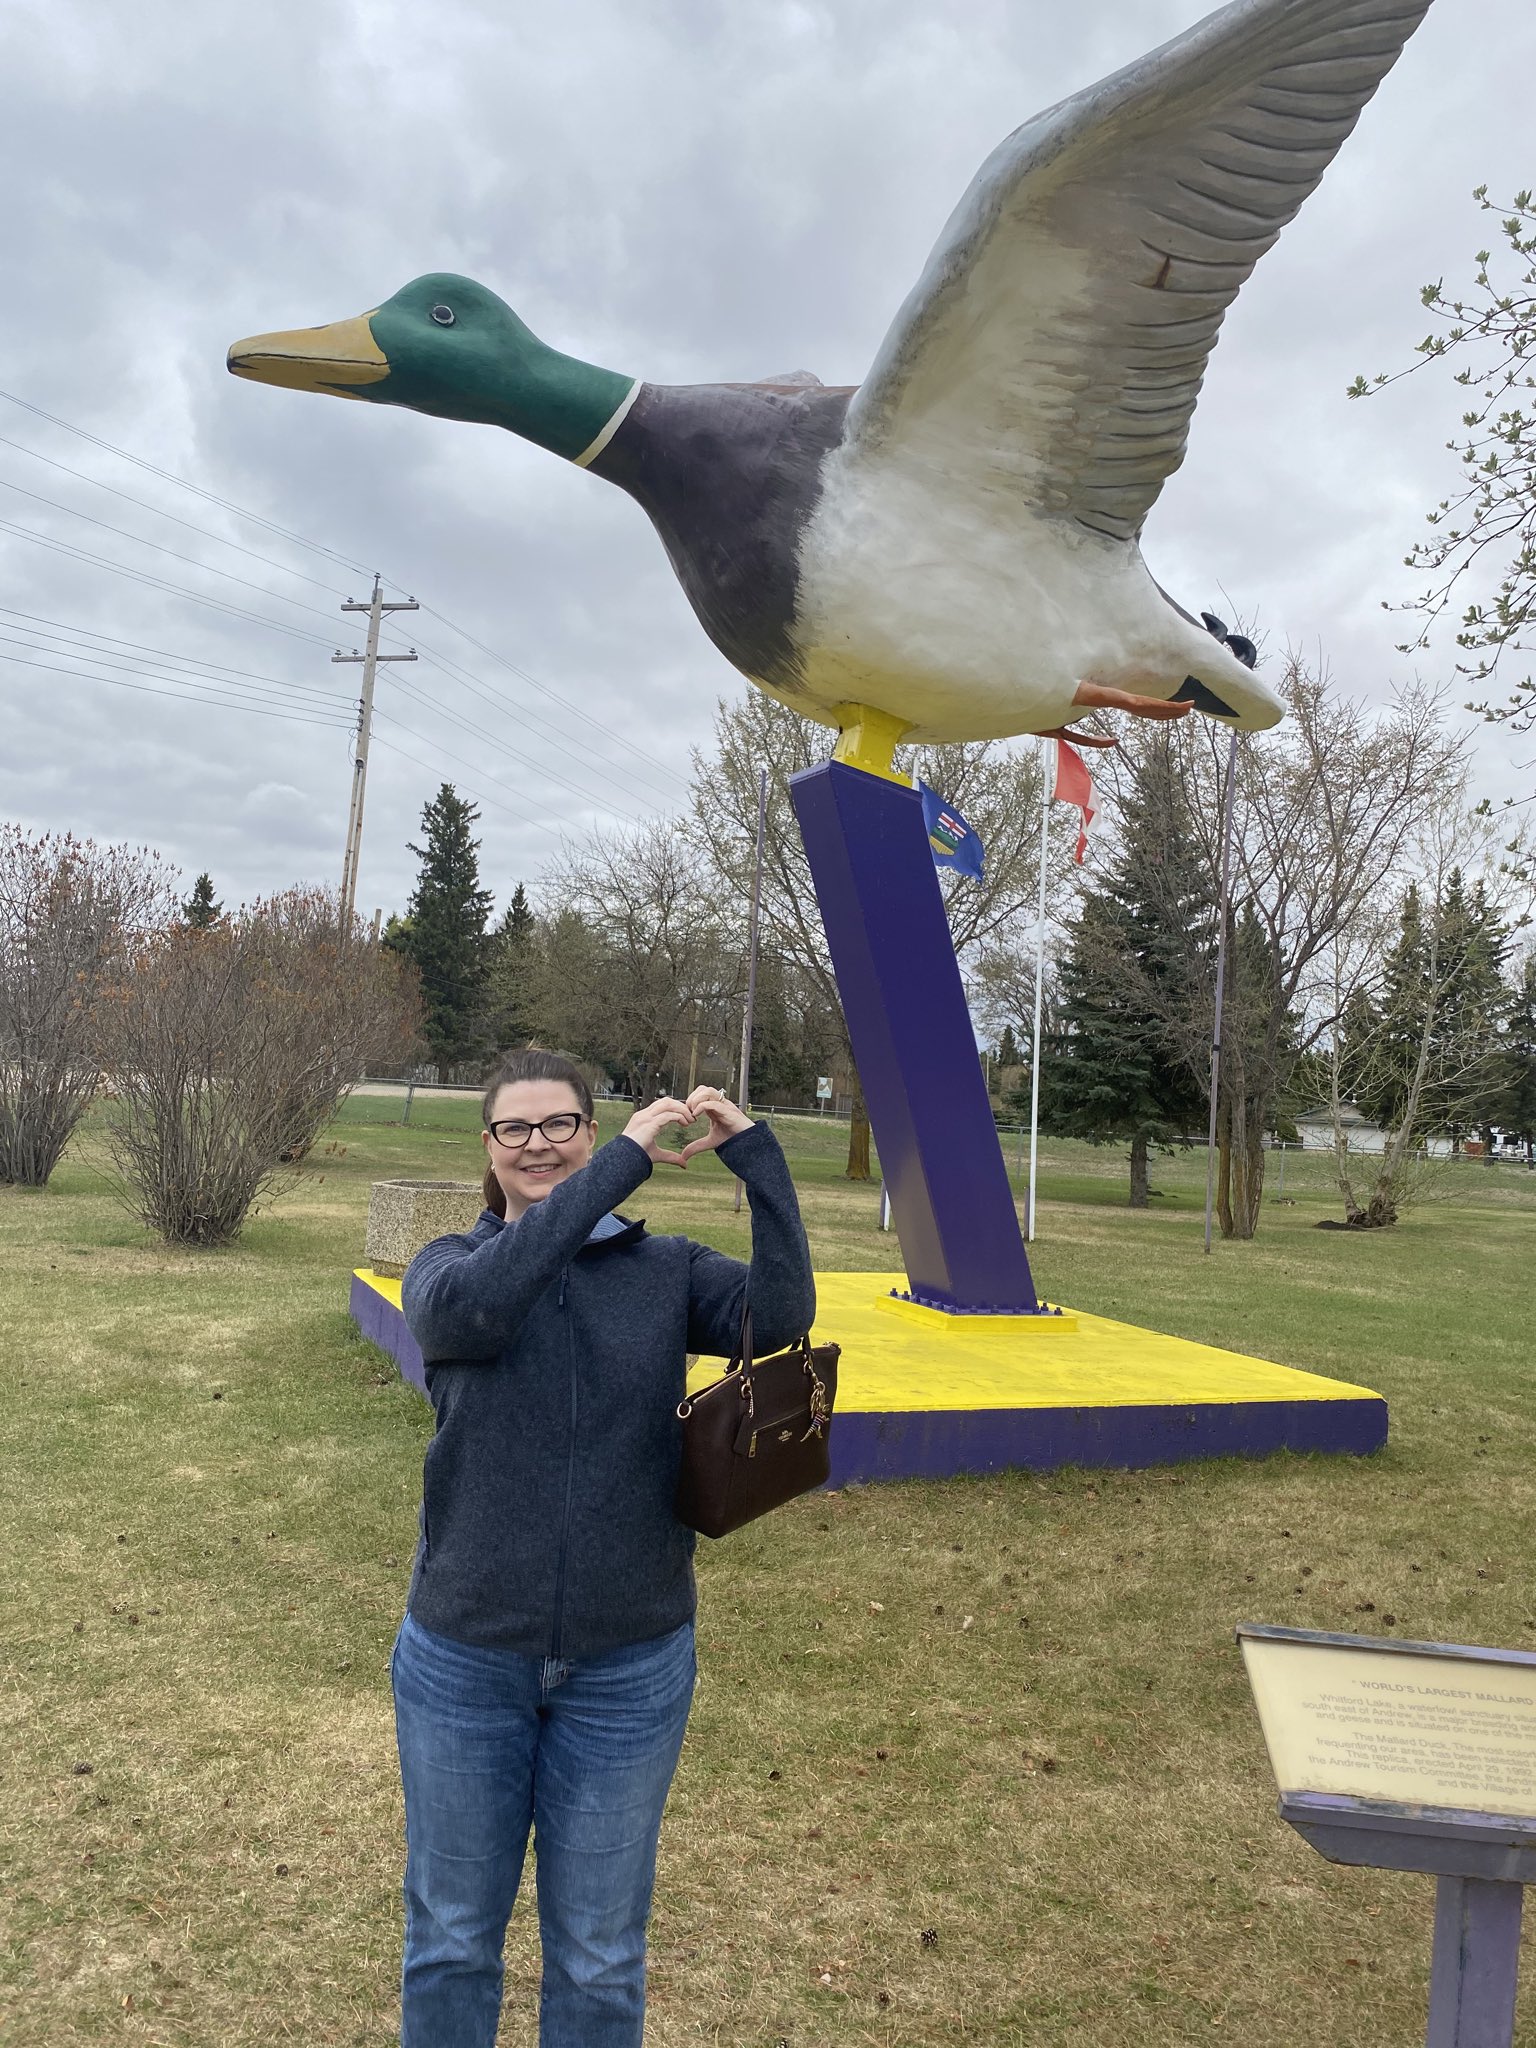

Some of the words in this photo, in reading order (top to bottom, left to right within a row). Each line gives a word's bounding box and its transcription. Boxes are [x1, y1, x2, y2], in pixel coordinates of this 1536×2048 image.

[1417, 1686, 1472, 1699] LARGEST
[1475, 1692, 1534, 1705] MALLARD
[1301, 1701, 1332, 1711] south
[1334, 1704, 1356, 1713] east
[1359, 1706, 1369, 1714] of
[1417, 1713, 1426, 1721] is
[1429, 1714, 1437, 1722] a
[1438, 1716, 1468, 1727] major
[1470, 1717, 1518, 1731] breeding
[1398, 1702, 1405, 1710] a
[1407, 1704, 1457, 1715] waterfowl
[1459, 1709, 1510, 1722] sanctuary
[1316, 1712, 1335, 1720] and
[1338, 1714, 1371, 1723] geese
[1374, 1718, 1393, 1726] and
[1396, 1719, 1406, 1727] is
[1407, 1720, 1450, 1732] situated
[1452, 1725, 1467, 1733] on
[1469, 1727, 1489, 1736] one
[1491, 1729, 1502, 1737] of
[1504, 1731, 1522, 1739] the
[1316, 1737, 1378, 1752] frequenting
[1379, 1744, 1397, 1752] our
[1430, 1749, 1451, 1759] has
[1453, 1752, 1481, 1762] been
[1483, 1755, 1530, 1767] selected
[1352, 1731, 1374, 1741] The
[1376, 1734, 1416, 1746] Mallard
[1452, 1742, 1474, 1752] The
[1476, 1746, 1504, 1755] most
[1308, 1755, 1326, 1764] the
[1329, 1757, 1371, 1768] Andrew
[1372, 1761, 1417, 1773] Tourism
[1484, 1774, 1504, 1783] the
[1346, 1749, 1369, 1760] This
[1414, 1758, 1455, 1769] erected
[1458, 1761, 1483, 1772] April
[1436, 1779, 1457, 1788] and
[1460, 1781, 1480, 1790] the
[1480, 1782, 1519, 1795] Village
[1521, 1787, 1533, 1796] of
